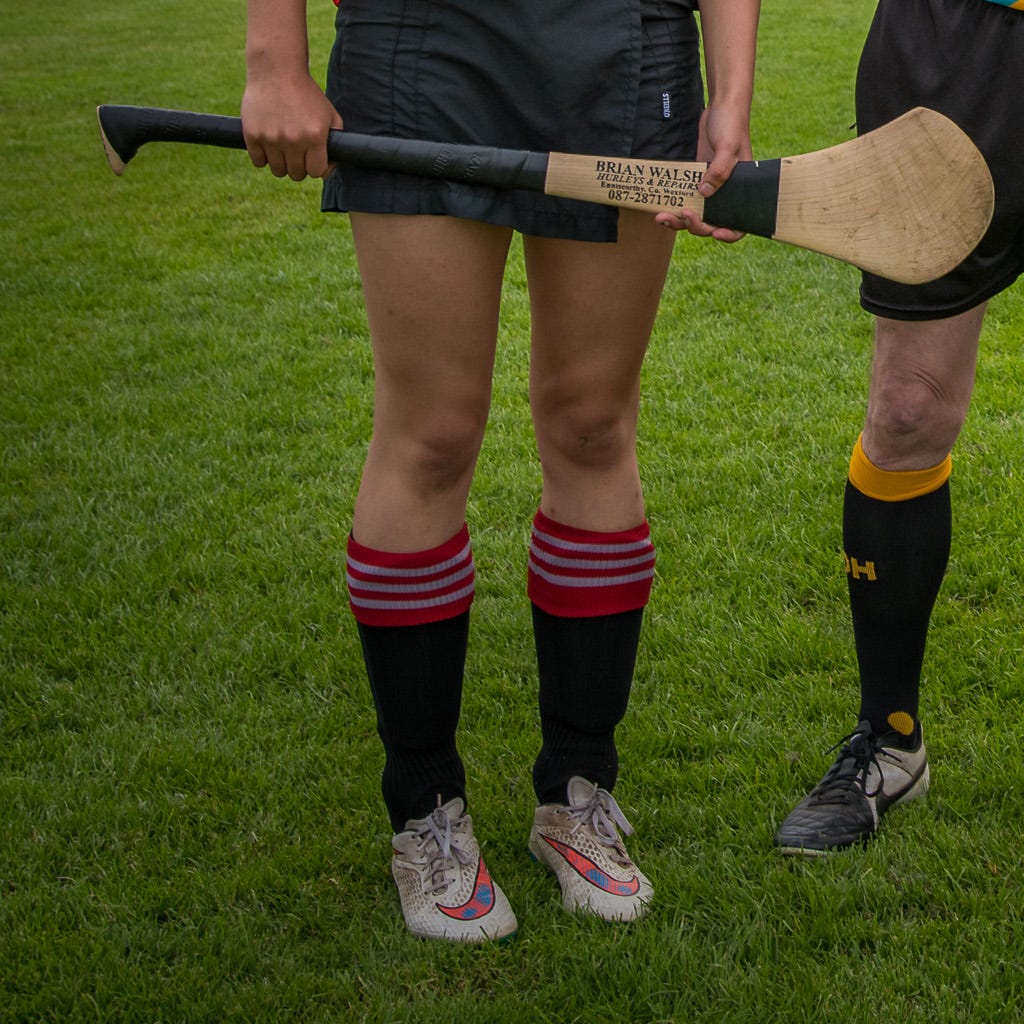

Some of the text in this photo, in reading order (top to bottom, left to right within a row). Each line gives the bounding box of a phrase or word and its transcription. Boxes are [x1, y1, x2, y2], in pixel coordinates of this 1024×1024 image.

[596, 160, 703, 183] BRIAN WALSH
[597, 173, 645, 185] HURLEYS
[657, 179, 700, 191] REPAIRS
[608, 189, 684, 207] 087-2871702
[664, 188, 694, 197] Wexford
